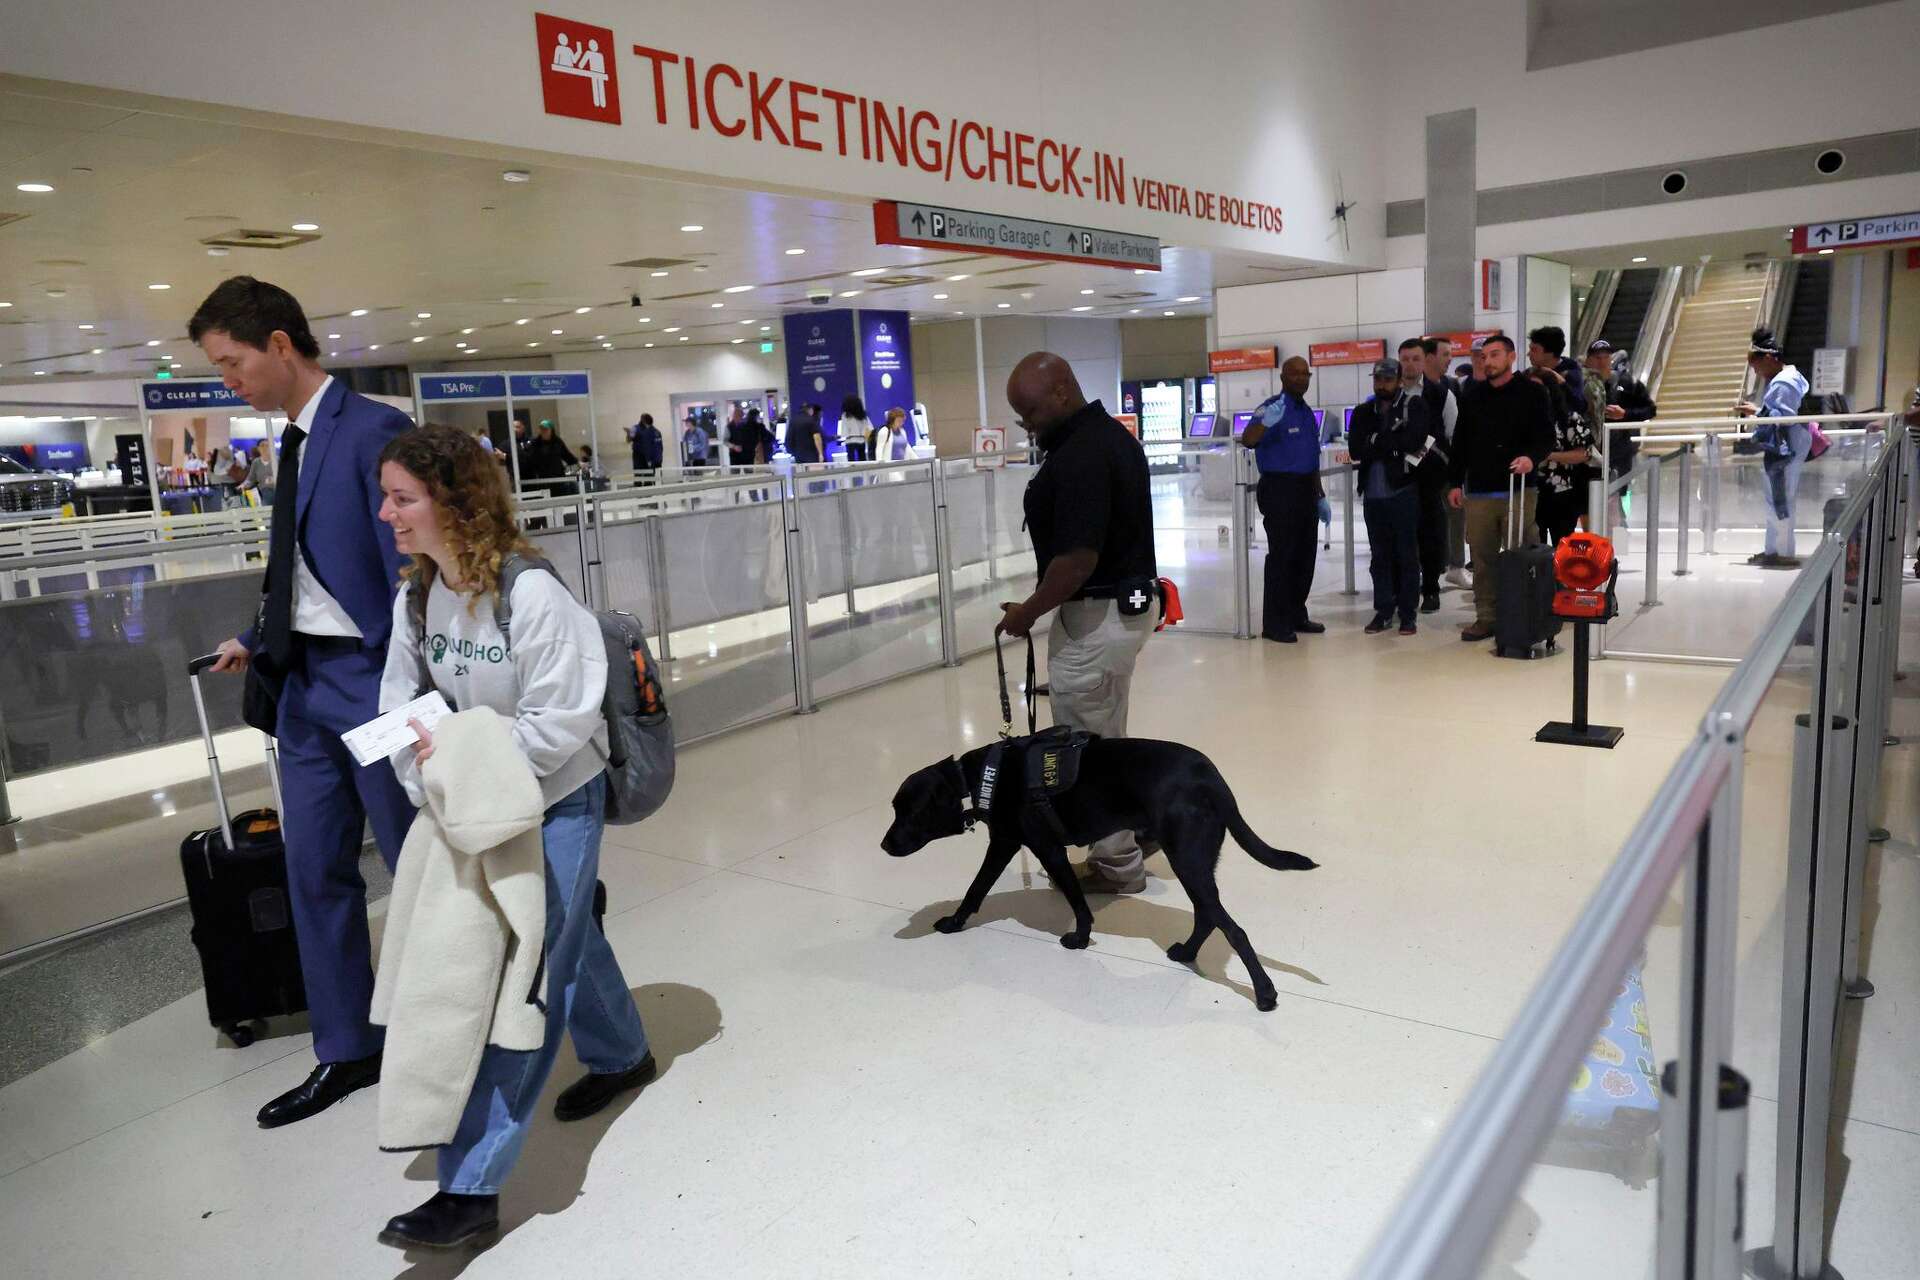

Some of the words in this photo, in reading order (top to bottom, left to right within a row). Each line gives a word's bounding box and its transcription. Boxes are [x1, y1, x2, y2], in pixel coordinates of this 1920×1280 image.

[633, 45, 1125, 205] TICKETING/CHECK-IN
[1133, 177, 1190, 216] VENTA
[1195, 191, 1215, 220] DE
[1220, 195, 1282, 233] BOLETOS
[933, 214, 944, 236] P
[948, 217, 995, 243] Parking
[999, 224, 1040, 249] Garage
[1043, 230, 1051, 248] C
[1096, 240, 1119, 256] Valet
[1121, 245, 1154, 262] Parking
[213, 390, 231, 399] TSA
[441, 383, 459, 393] TSA
[460, 382, 475, 392] Pre
[1044, 752, 1057, 771] UNIT
[983, 765, 996, 781] PET
[980, 782, 993, 799] NOT
